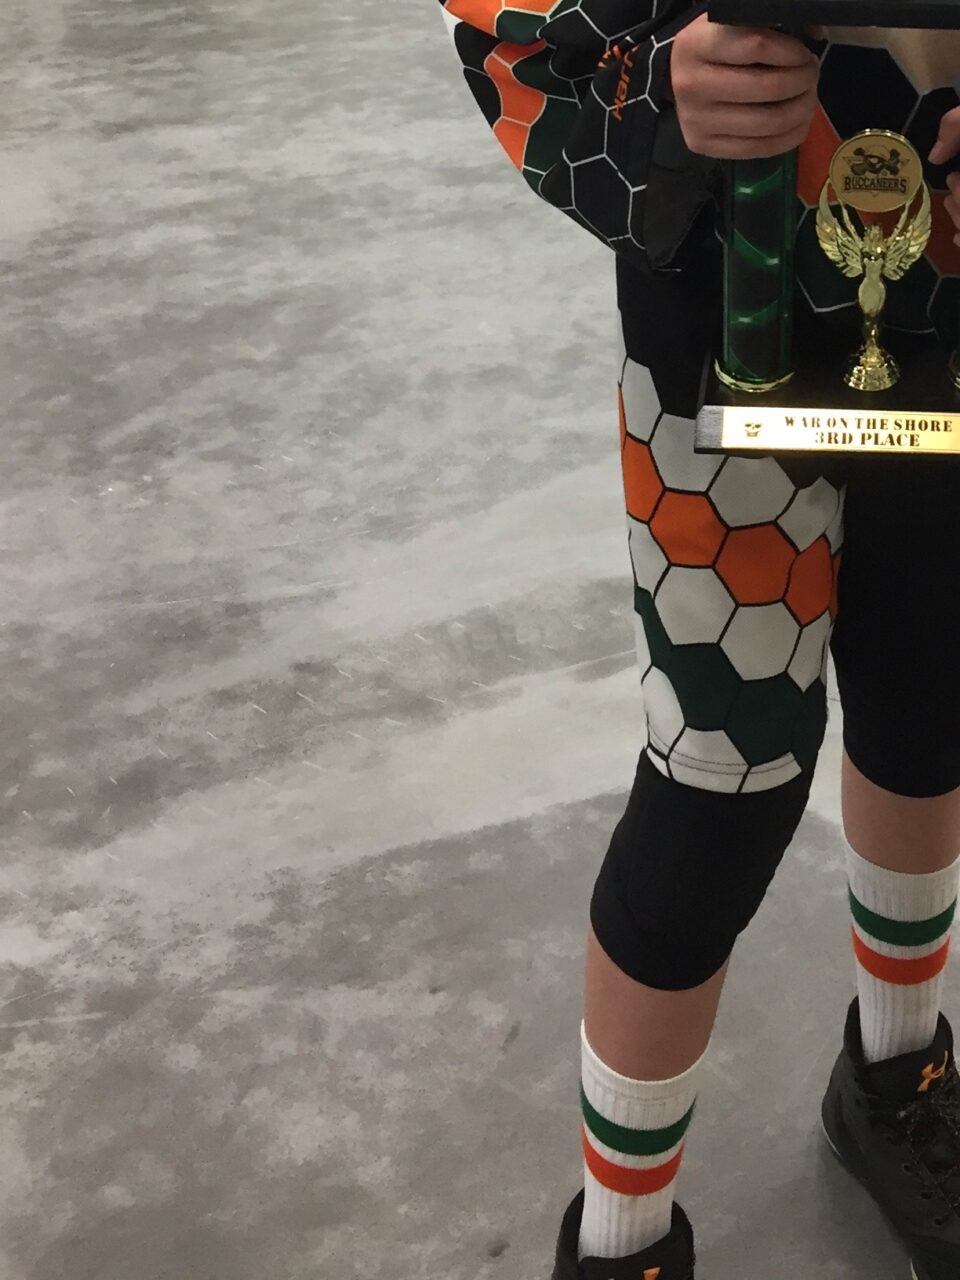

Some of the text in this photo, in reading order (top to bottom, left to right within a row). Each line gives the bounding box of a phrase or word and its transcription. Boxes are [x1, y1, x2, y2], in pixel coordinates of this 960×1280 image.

[843, 175, 908, 193] BUCCANEERS
[784, 415, 953, 433] WAR ON THE SHORE
[815, 431, 921, 447] 3RD PLACE
